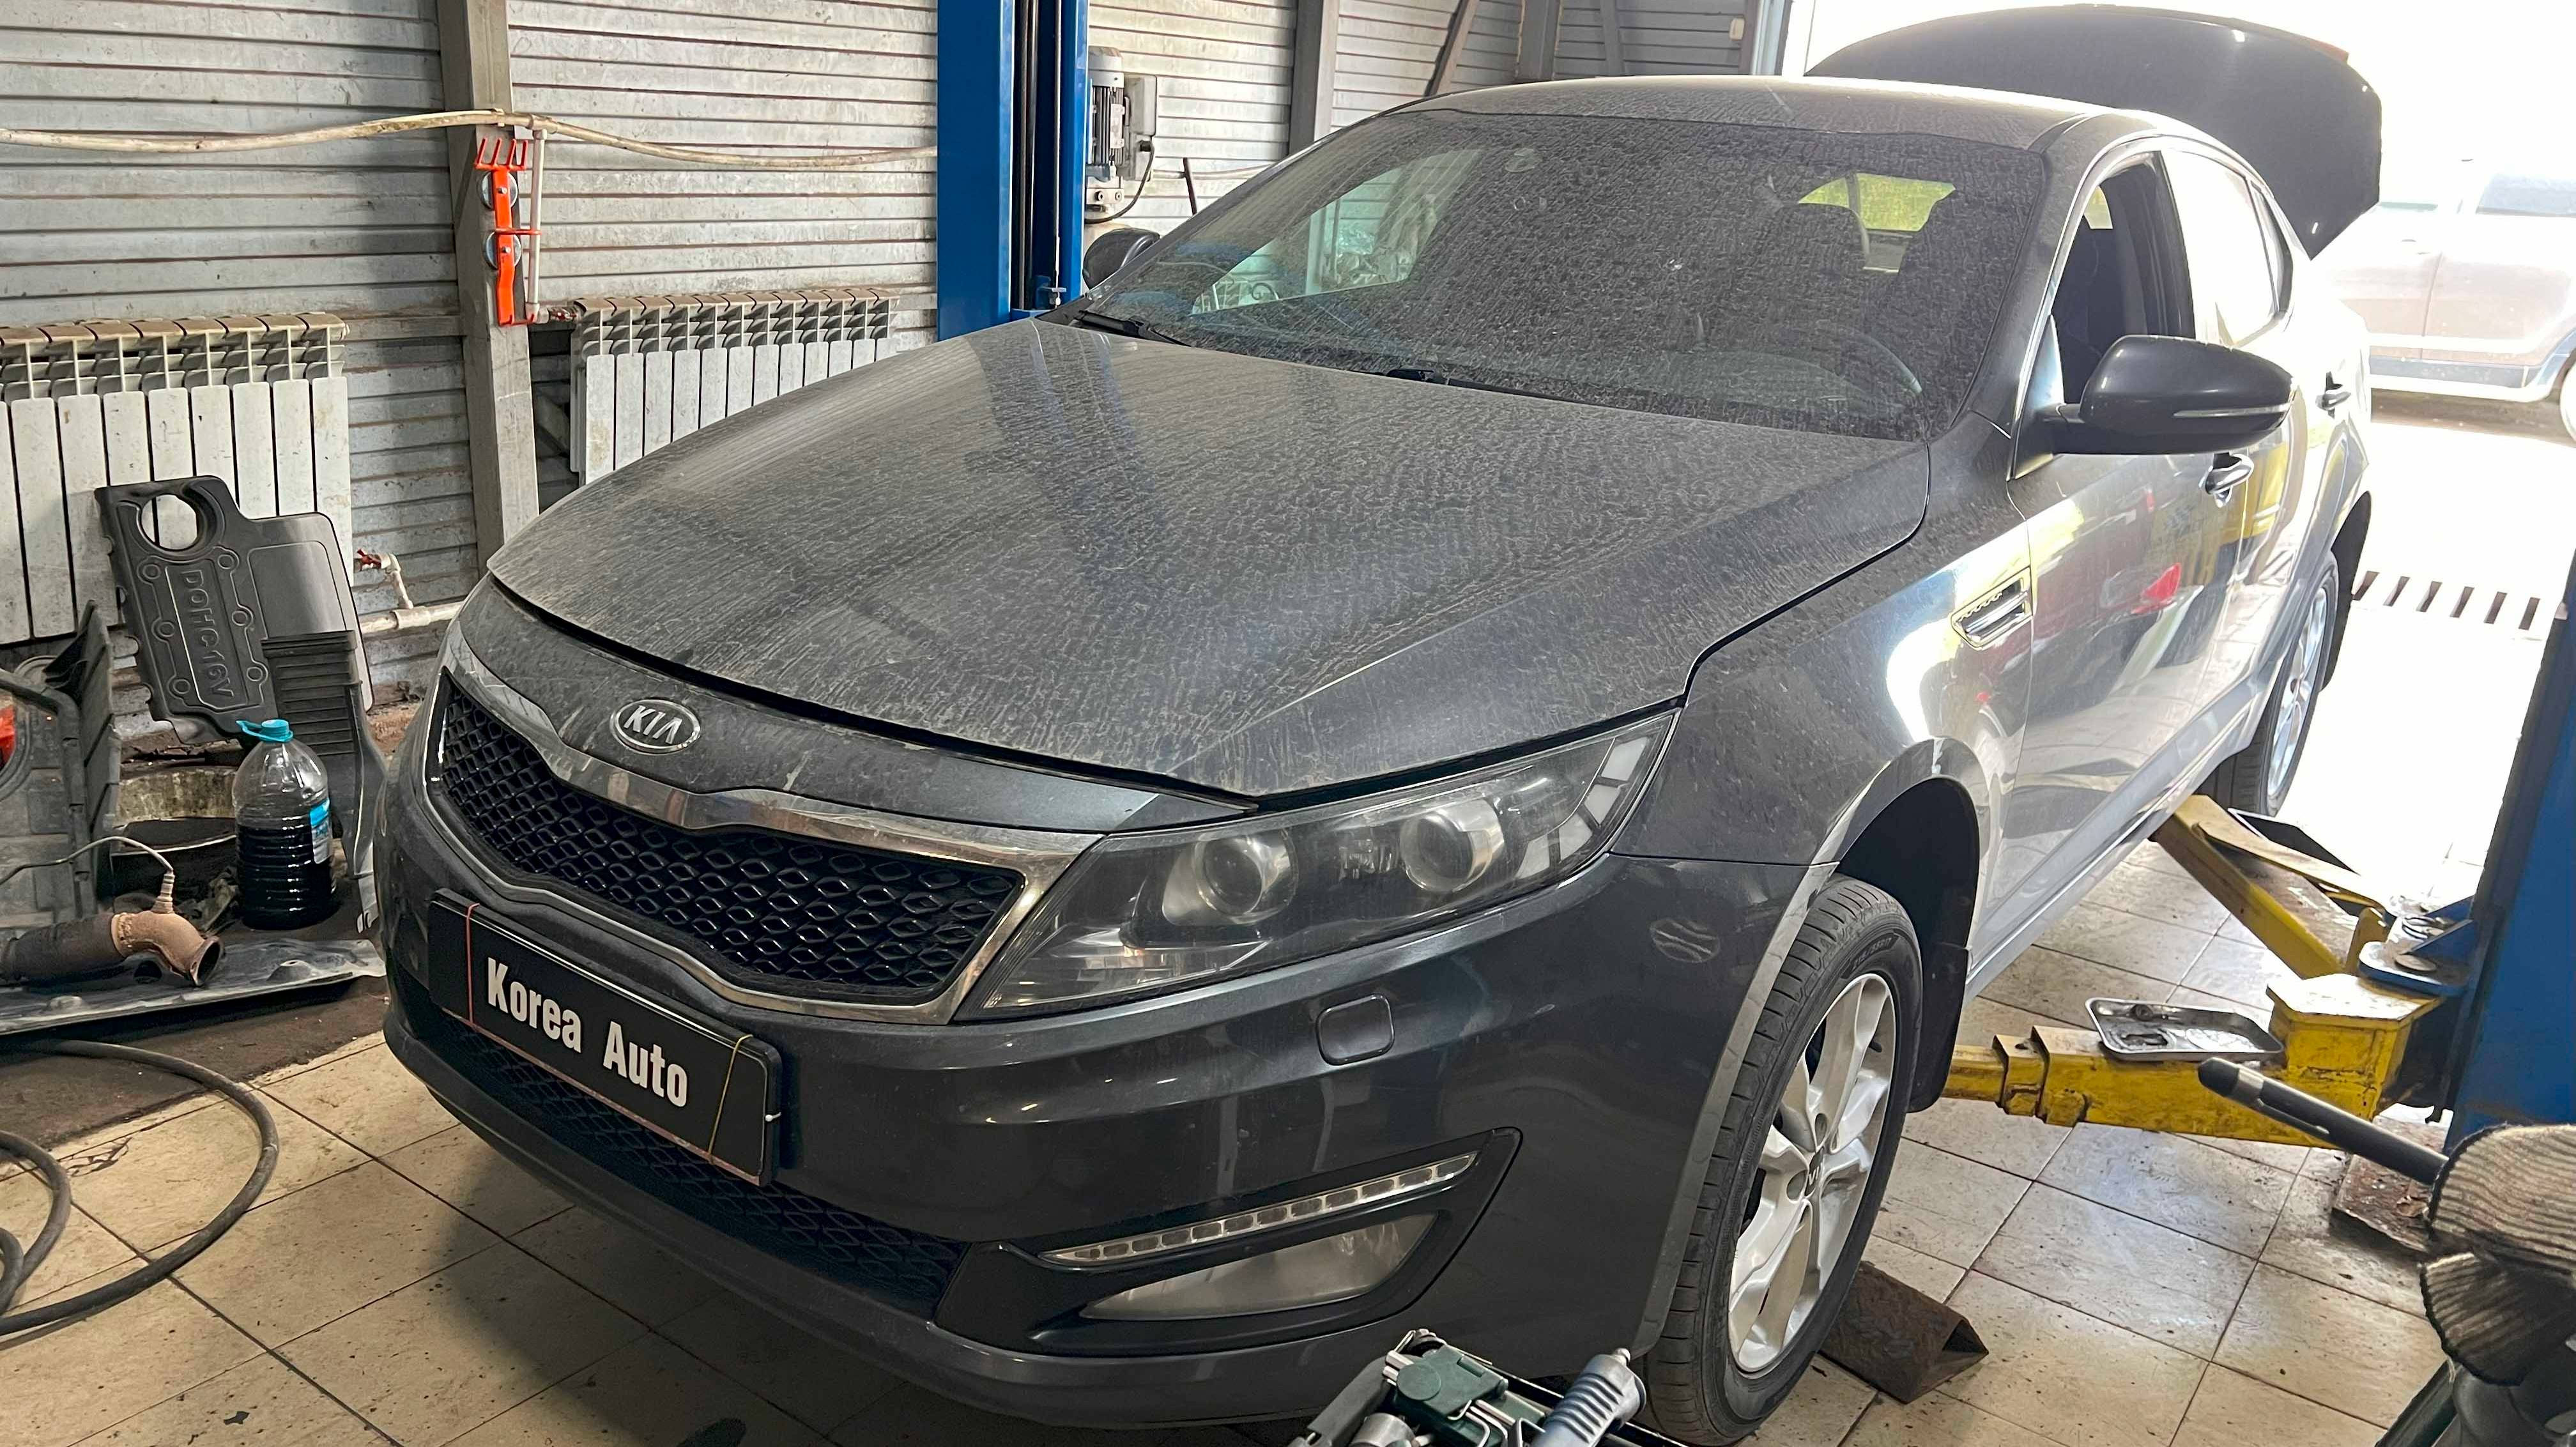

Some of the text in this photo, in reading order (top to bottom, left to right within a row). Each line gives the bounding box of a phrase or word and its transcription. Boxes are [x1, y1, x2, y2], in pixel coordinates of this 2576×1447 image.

[623, 705, 683, 744] KIA
[487, 956, 688, 1108] Korea Auto
